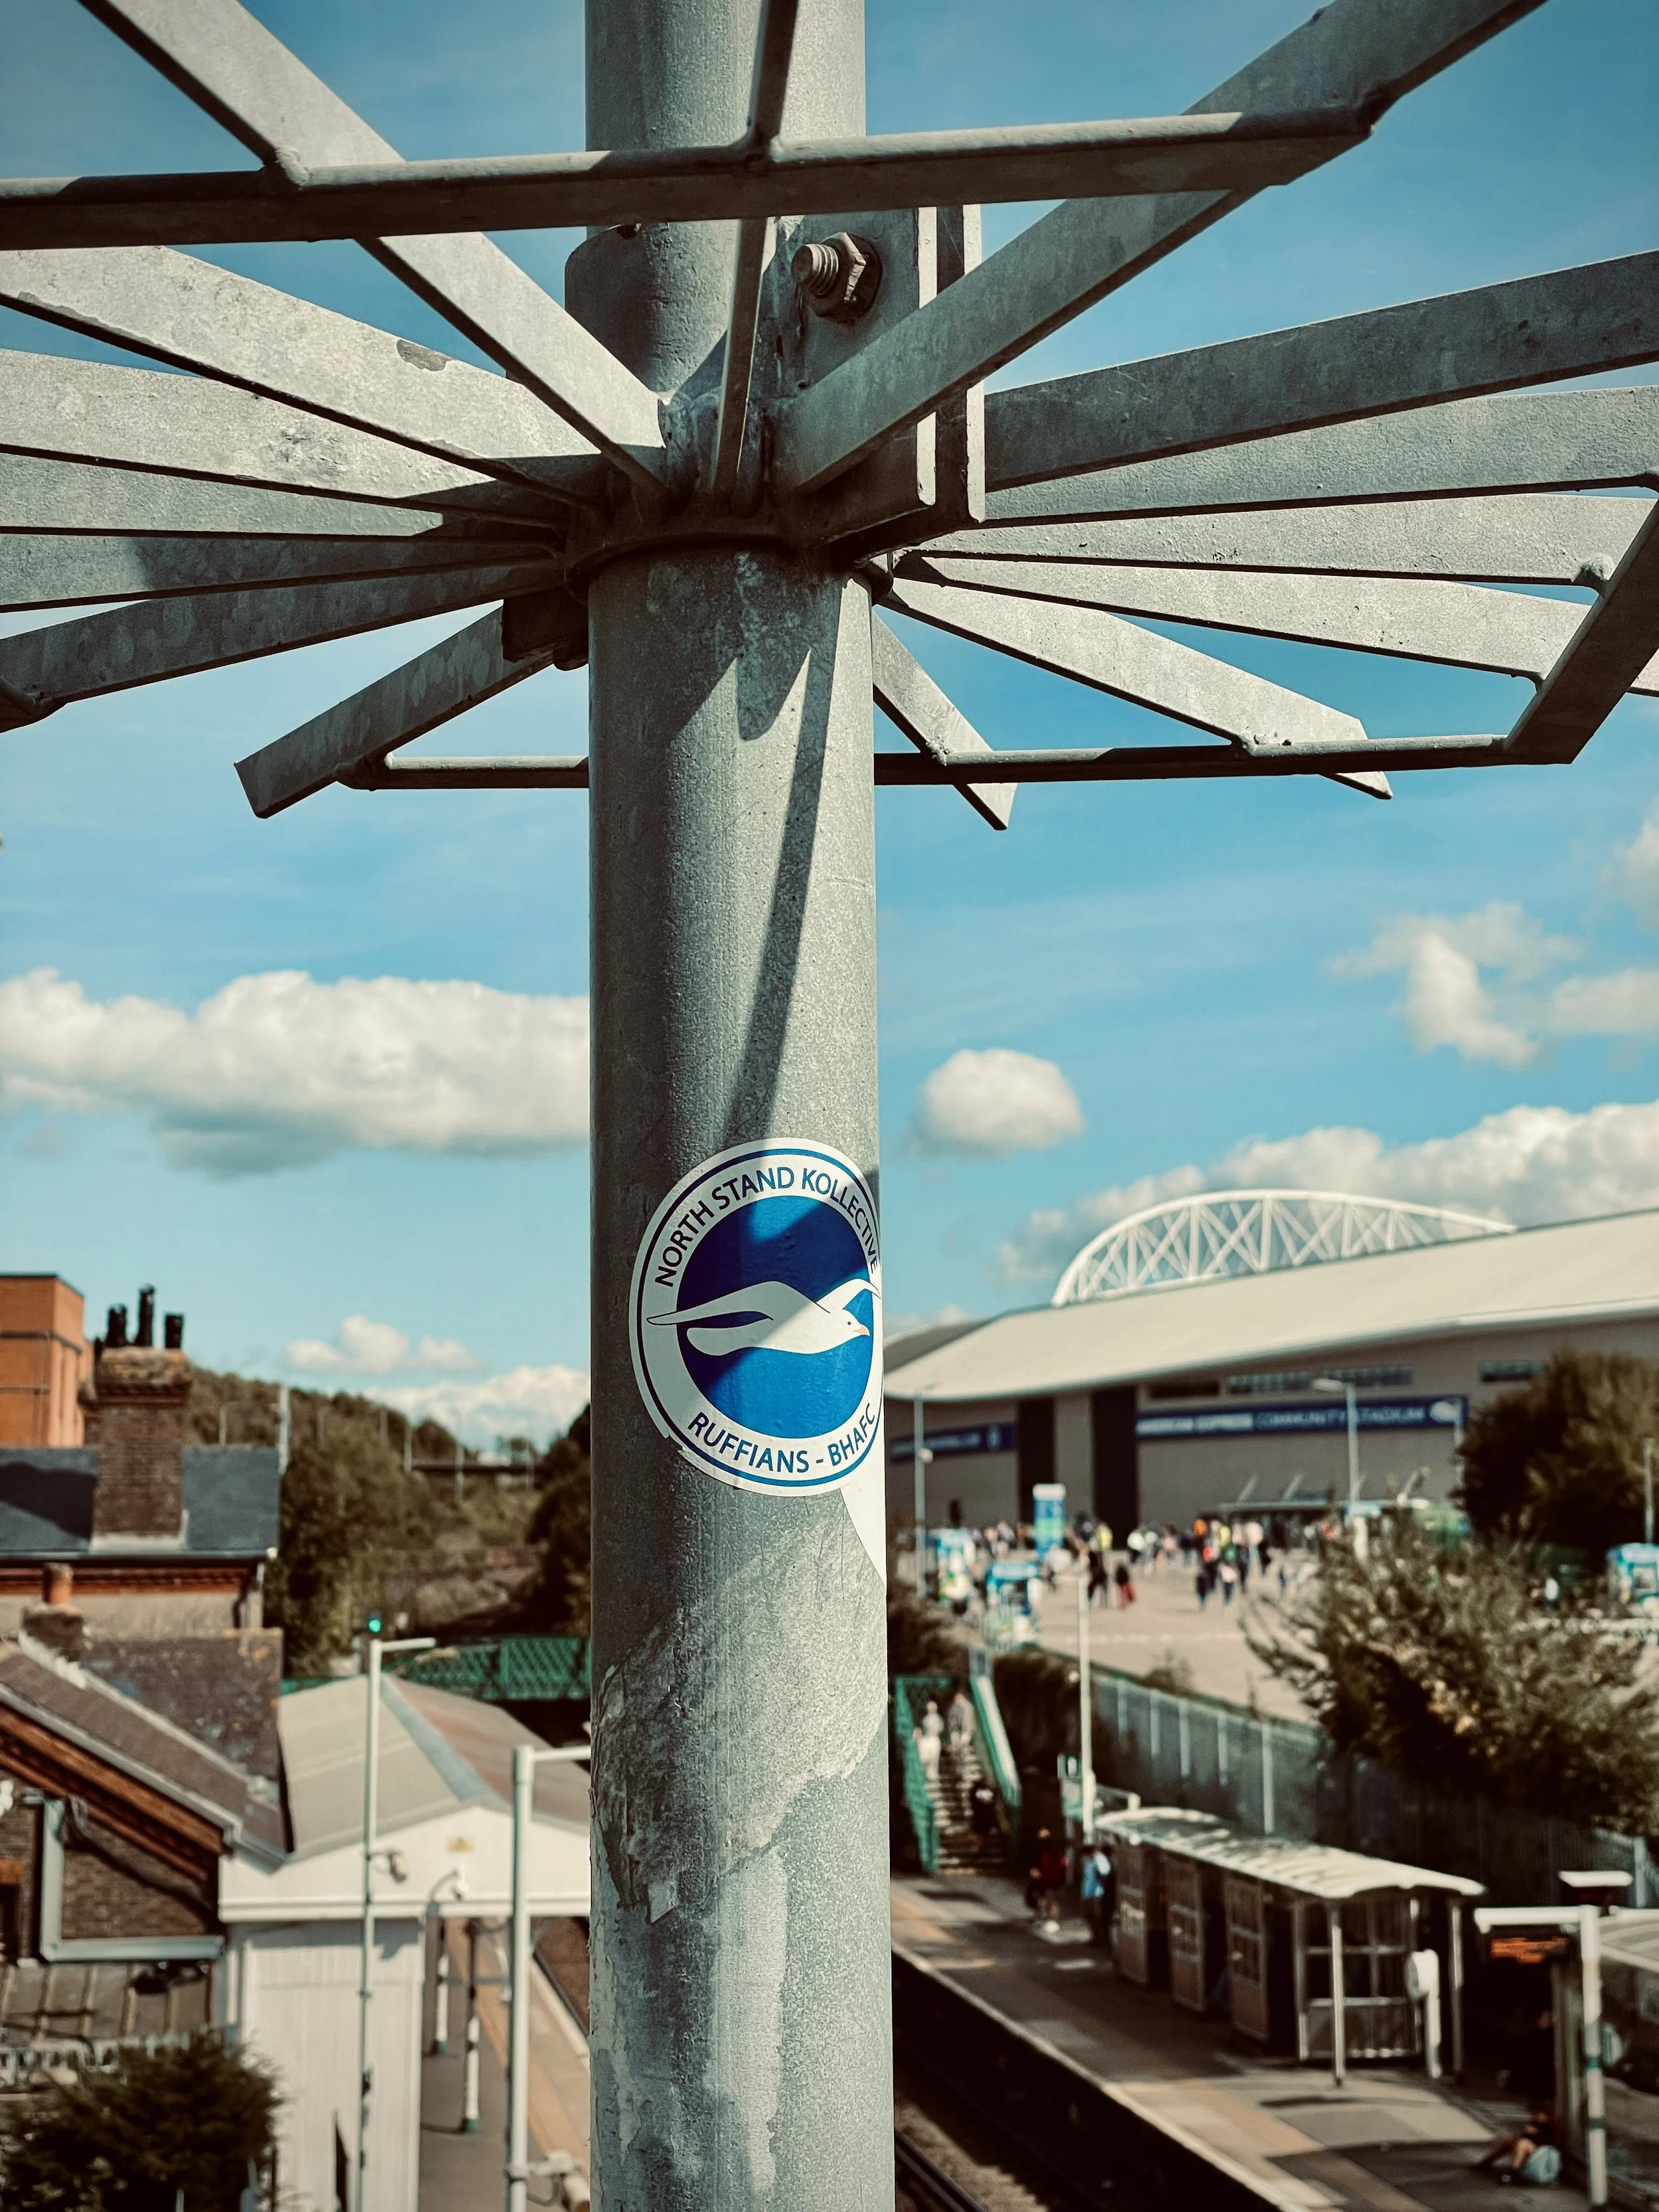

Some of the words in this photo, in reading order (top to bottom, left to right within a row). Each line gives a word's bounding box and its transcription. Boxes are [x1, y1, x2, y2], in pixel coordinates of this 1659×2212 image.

[654, 1200, 714, 1288] NORTH
[711, 1167, 795, 1210] STAND
[802, 1168, 878, 1274] KOLLECTIVE
[687, 1412, 810, 1473] RUFFIANS
[828, 1402, 875, 1467] BHAFC
